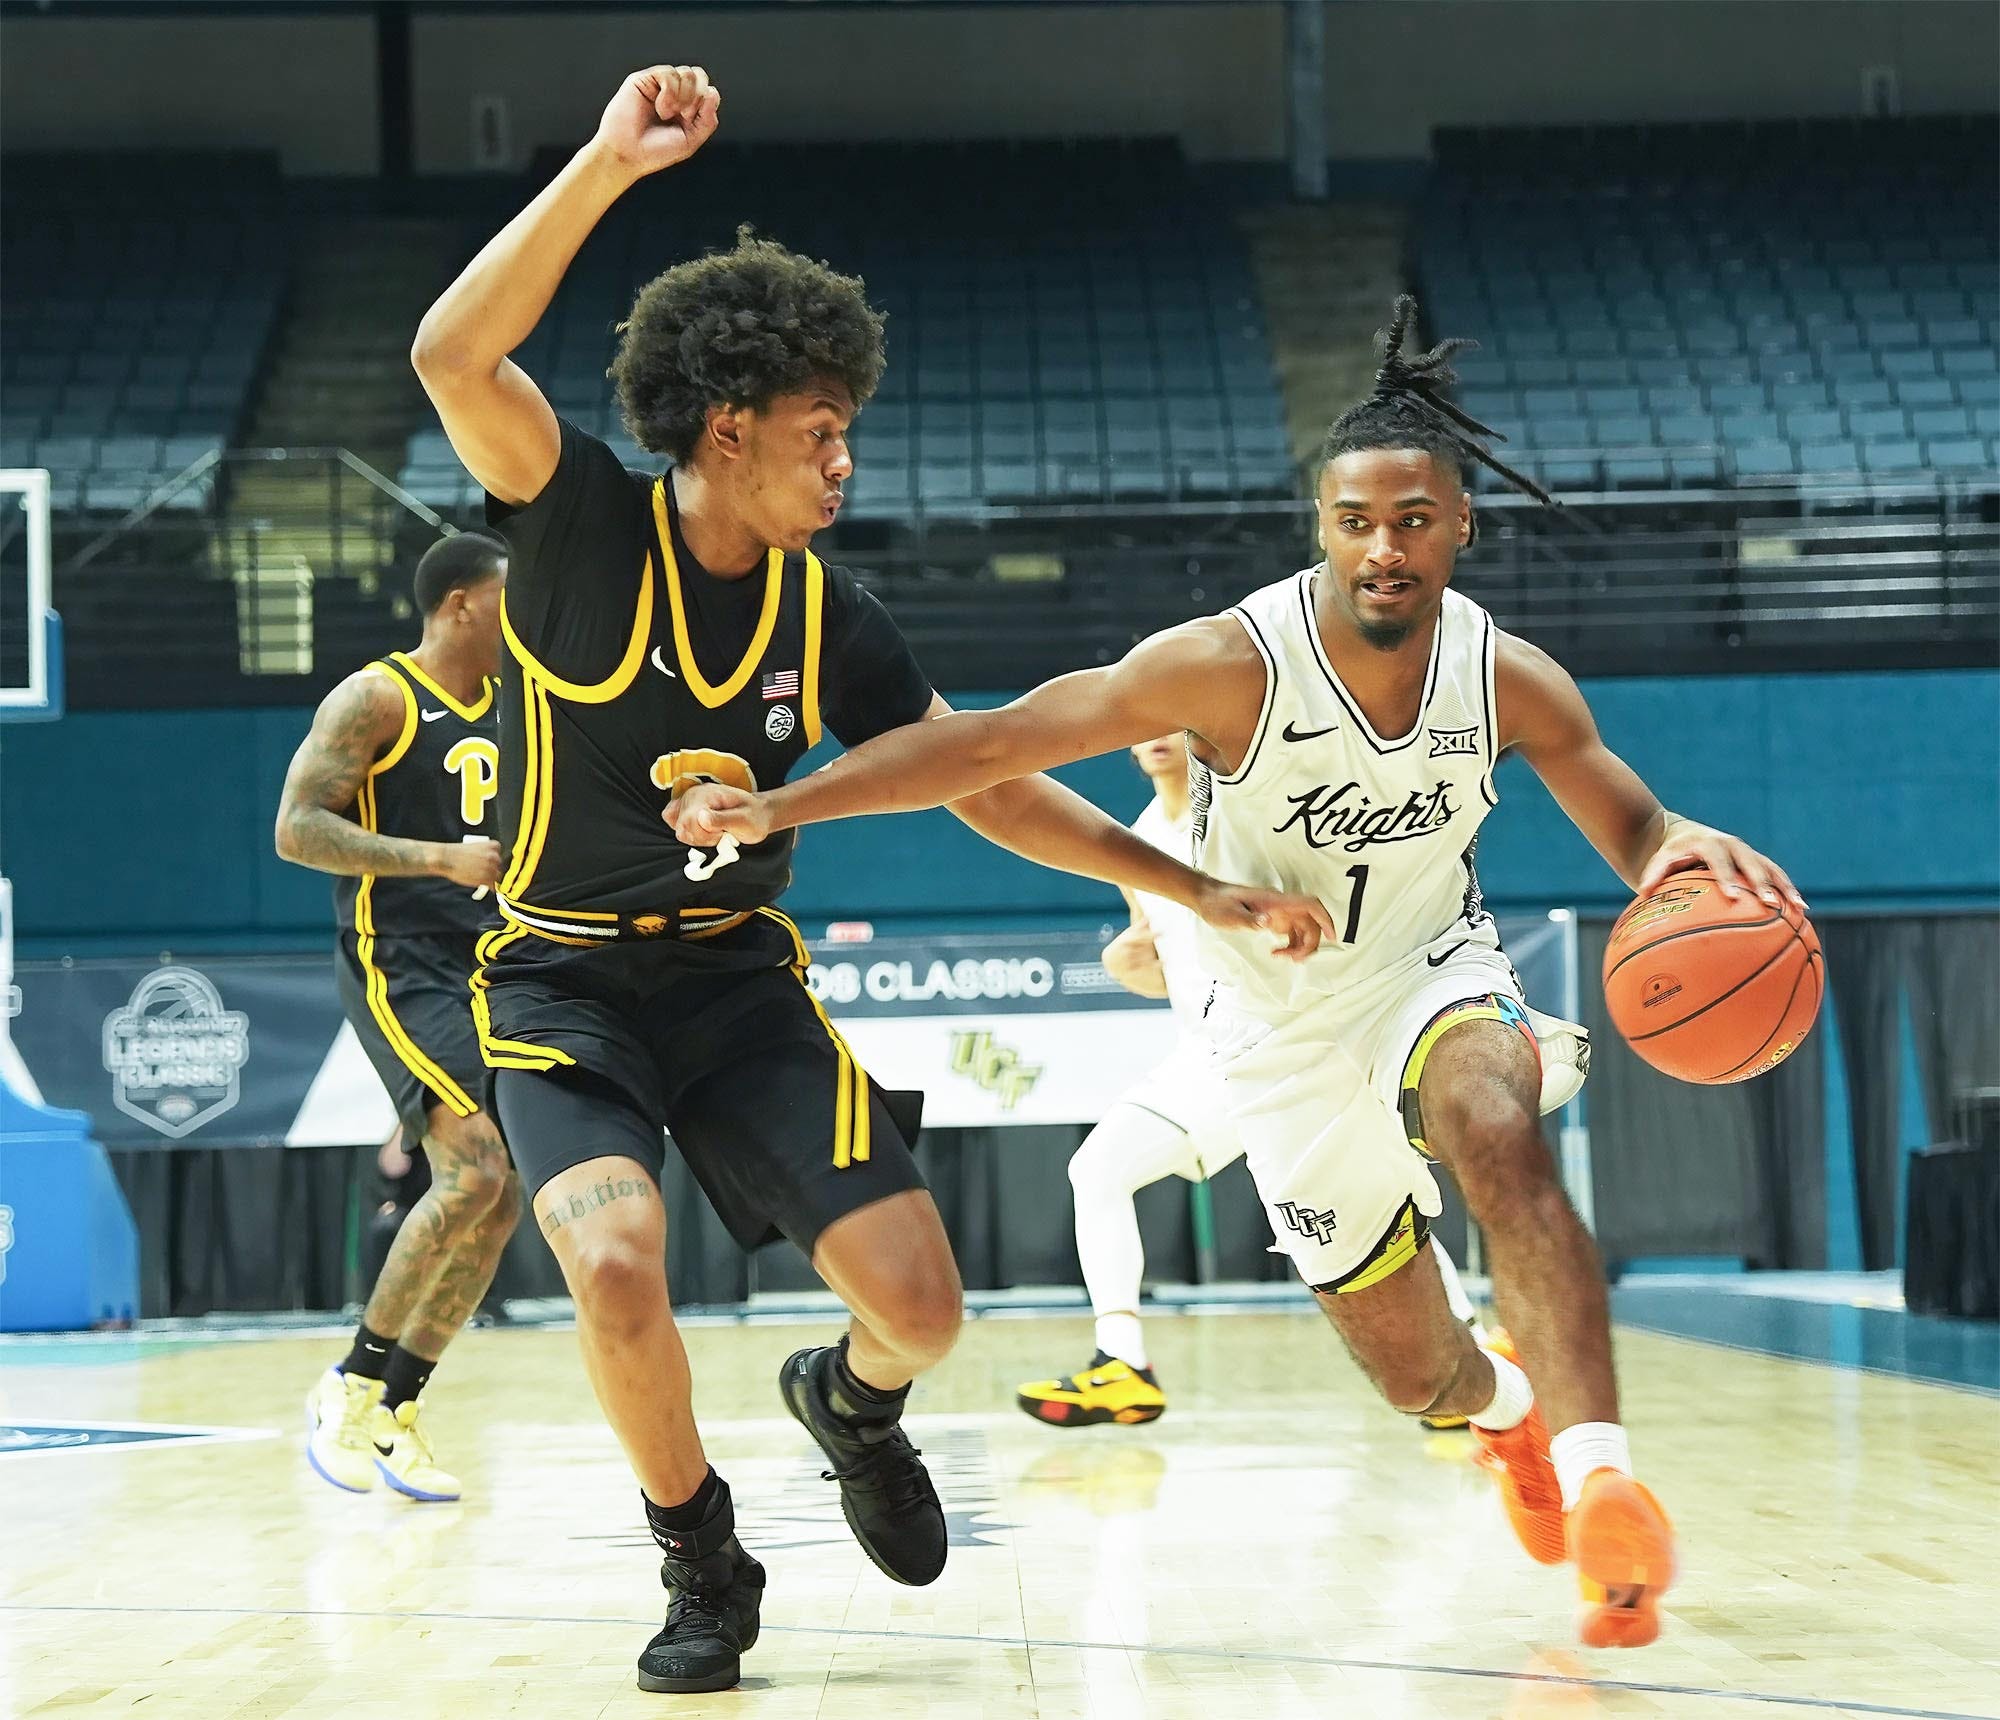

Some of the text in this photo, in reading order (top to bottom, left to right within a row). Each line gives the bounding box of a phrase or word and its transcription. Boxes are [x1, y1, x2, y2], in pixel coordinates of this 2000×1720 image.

[443, 736, 499, 826] P
[1273, 780, 1461, 852] Knights
[1343, 864, 1369, 944] 1
[866, 957, 1054, 1001] CLASSIC
[951, 1028, 1042, 1109] UCF
[1274, 1201, 1336, 1246] UCF
